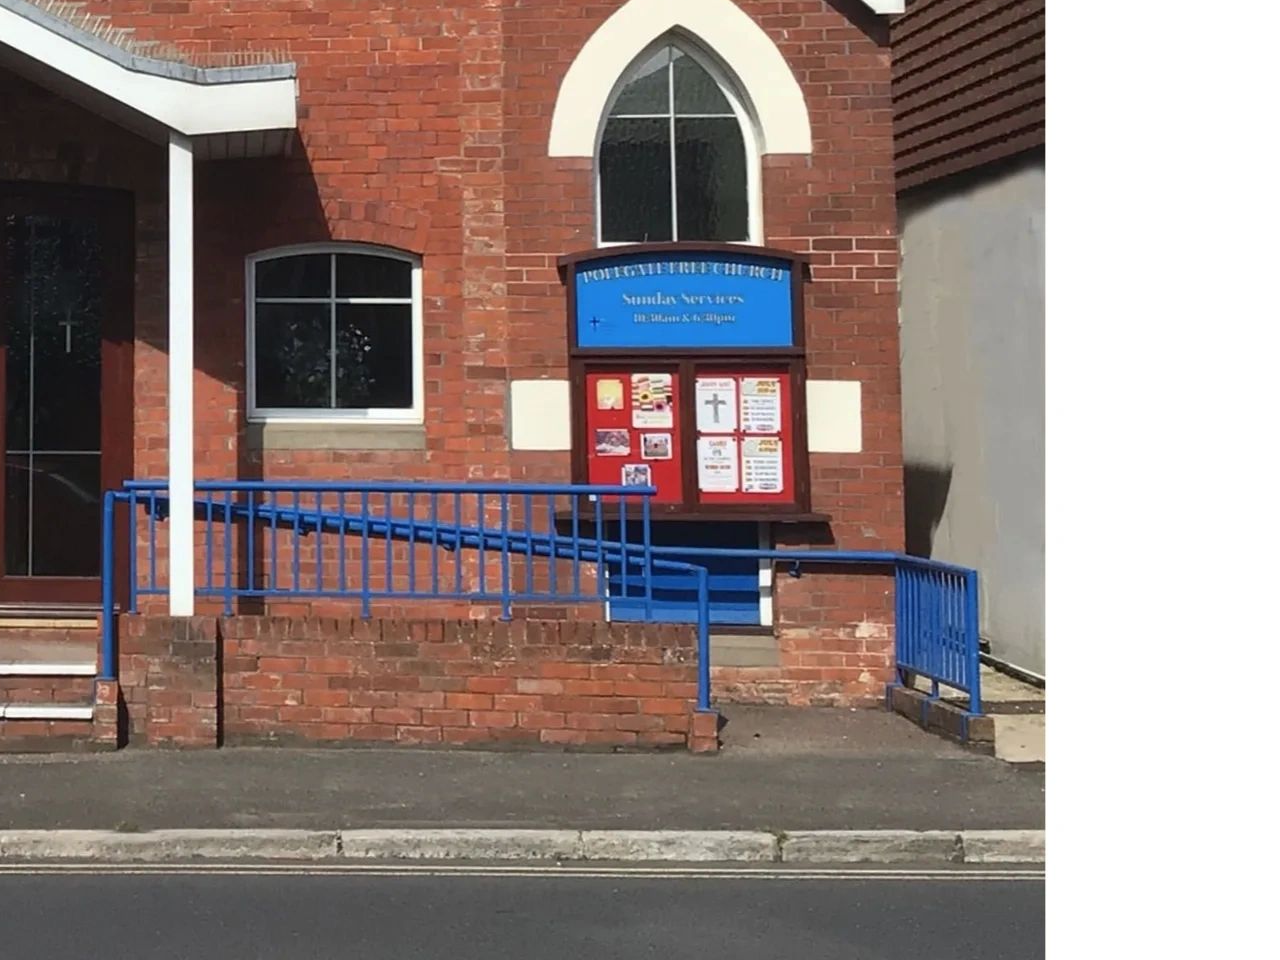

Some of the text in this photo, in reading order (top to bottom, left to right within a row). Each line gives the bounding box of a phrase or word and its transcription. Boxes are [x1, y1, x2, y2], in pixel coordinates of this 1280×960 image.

[712, 262, 784, 281] CHURCH
[622, 291, 744, 306] Sunday Services
